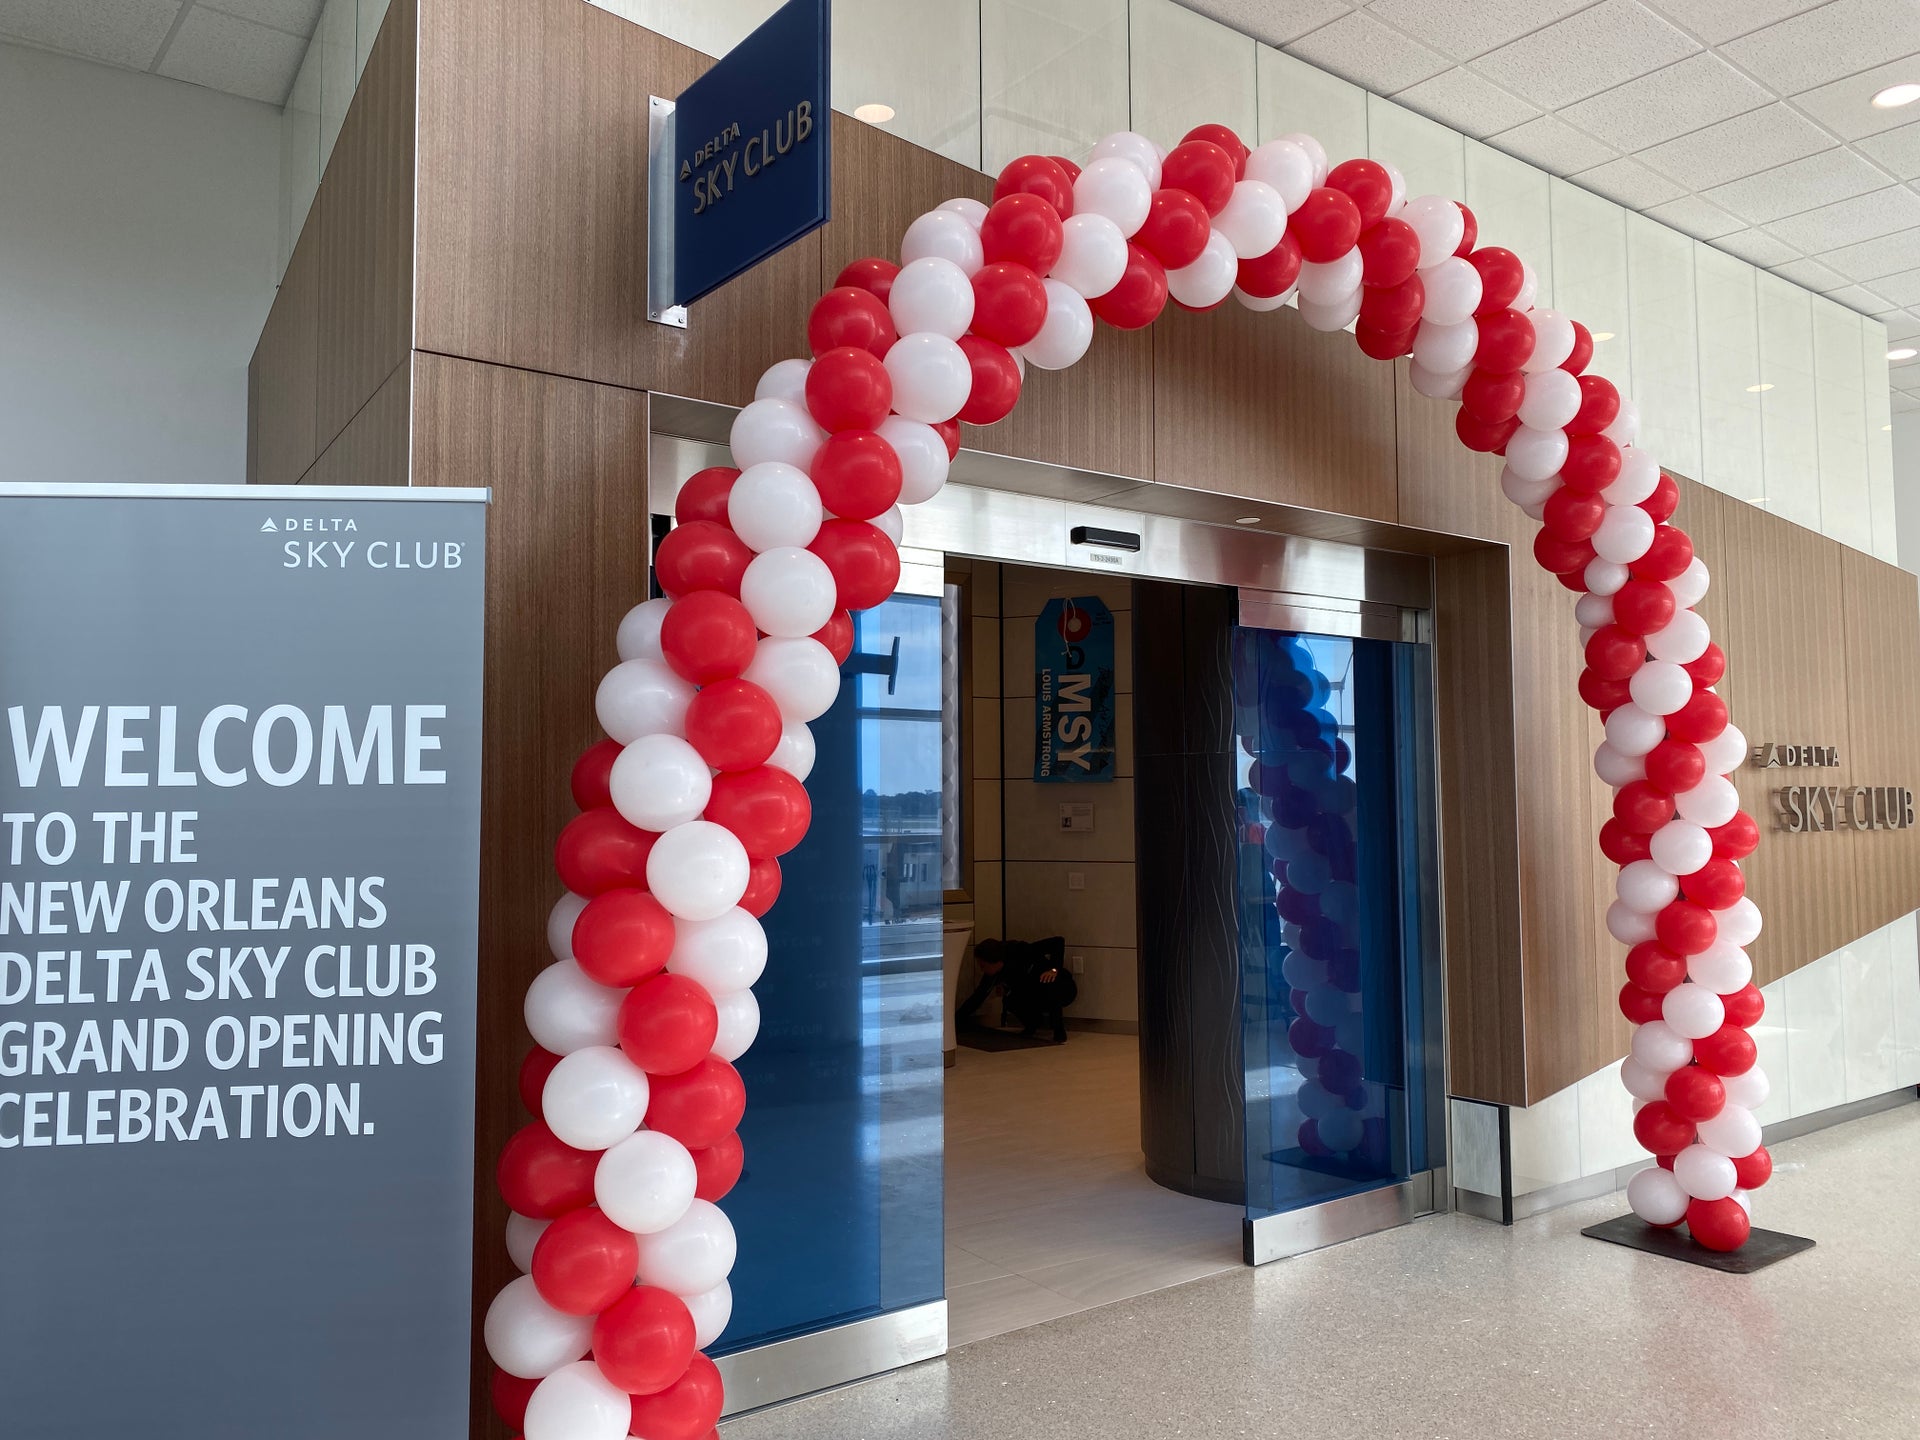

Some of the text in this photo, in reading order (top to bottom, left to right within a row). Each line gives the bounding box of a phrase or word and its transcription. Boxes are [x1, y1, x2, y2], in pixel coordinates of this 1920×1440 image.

[694, 100, 813, 214] SKY CLUB
[695, 122, 740, 167] DELTA
[283, 540, 355, 568] SKY
[285, 518, 358, 532] DELTA
[7, 704, 447, 787] WELCOME
[1040, 668, 1051, 777] LOUIS ARMSTRONG
[1057, 674, 1092, 771] MSY
[1786, 745, 1840, 767] DELTA
[2, 811, 198, 865] TO THE
[1786, 786, 1915, 833] SKY CLUB
[0, 876, 388, 935] NEW ORLEANS
[0, 944, 437, 1005] DELTA SKY CLUB
[0, 1011, 444, 1077] GRAND OPENING
